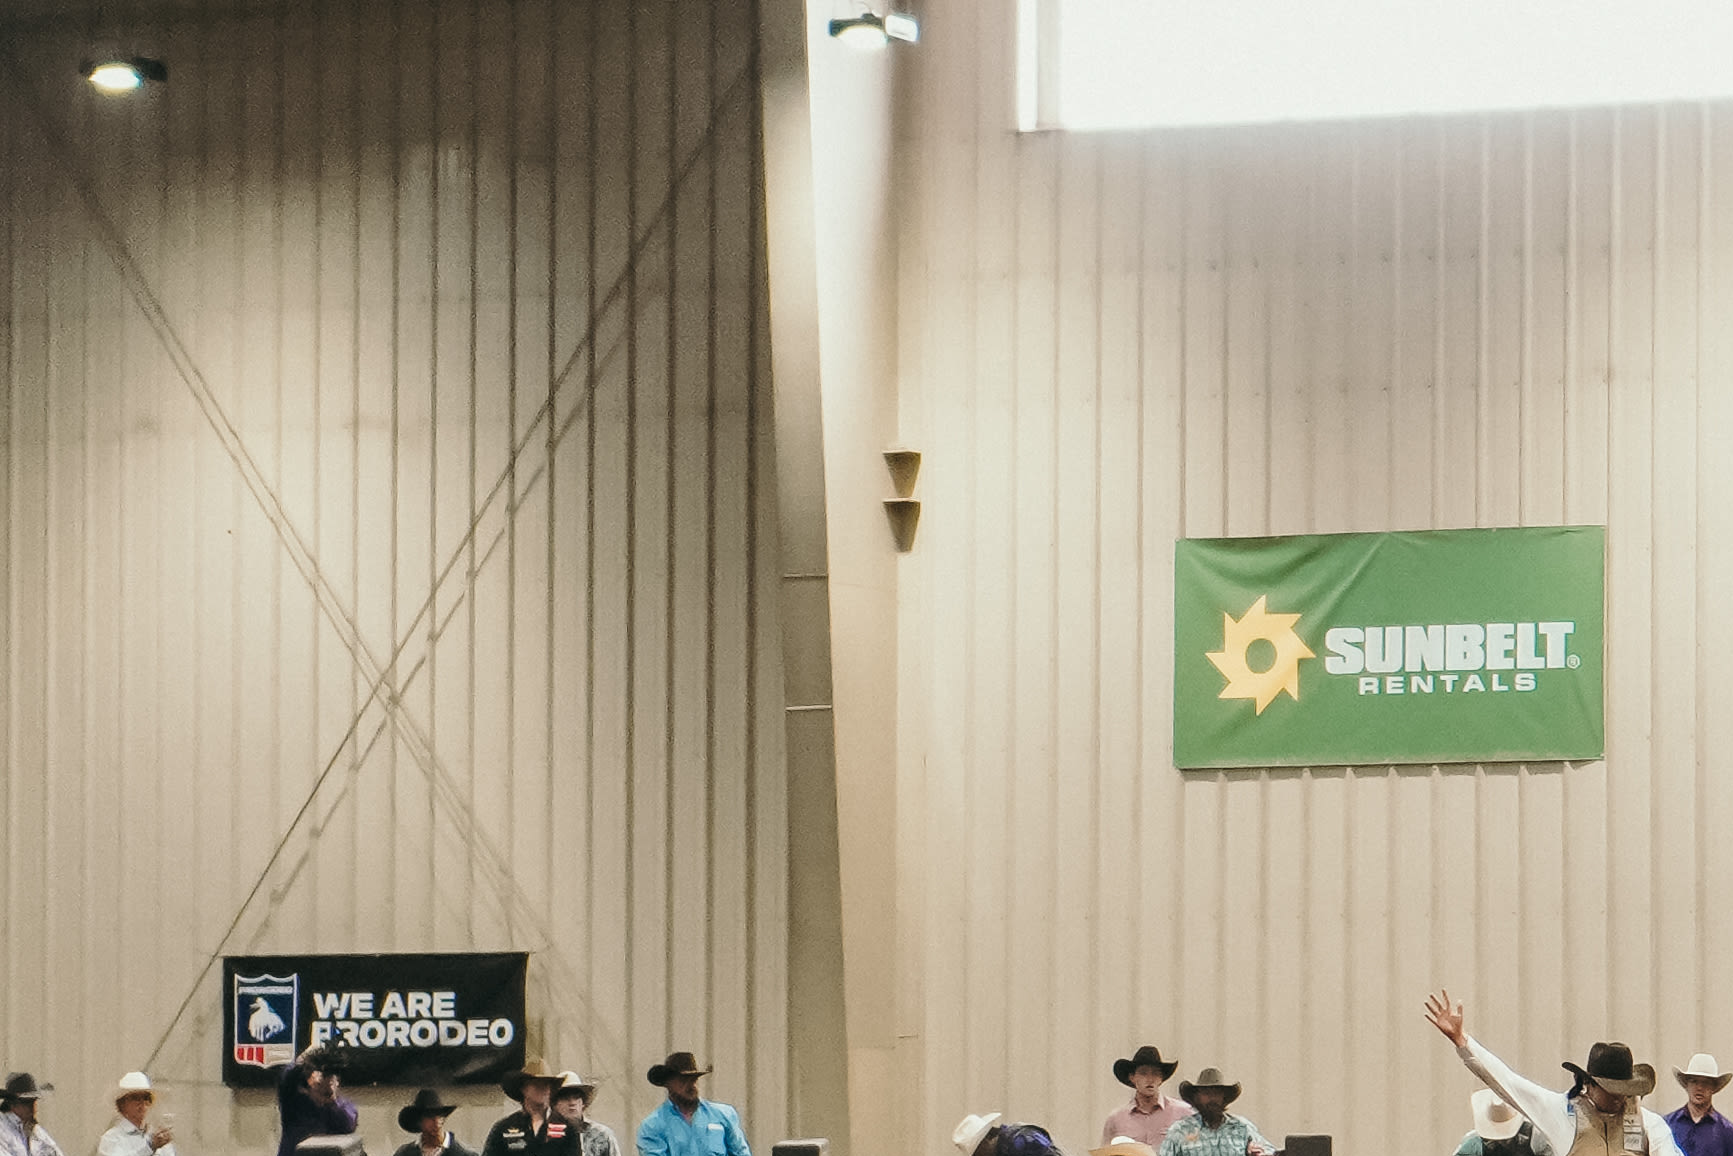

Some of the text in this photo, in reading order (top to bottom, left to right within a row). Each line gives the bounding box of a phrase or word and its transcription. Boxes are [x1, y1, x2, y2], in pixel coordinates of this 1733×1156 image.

[1359, 673, 1538, 695] RENTALS
[313, 991, 456, 1018] WE ARE
